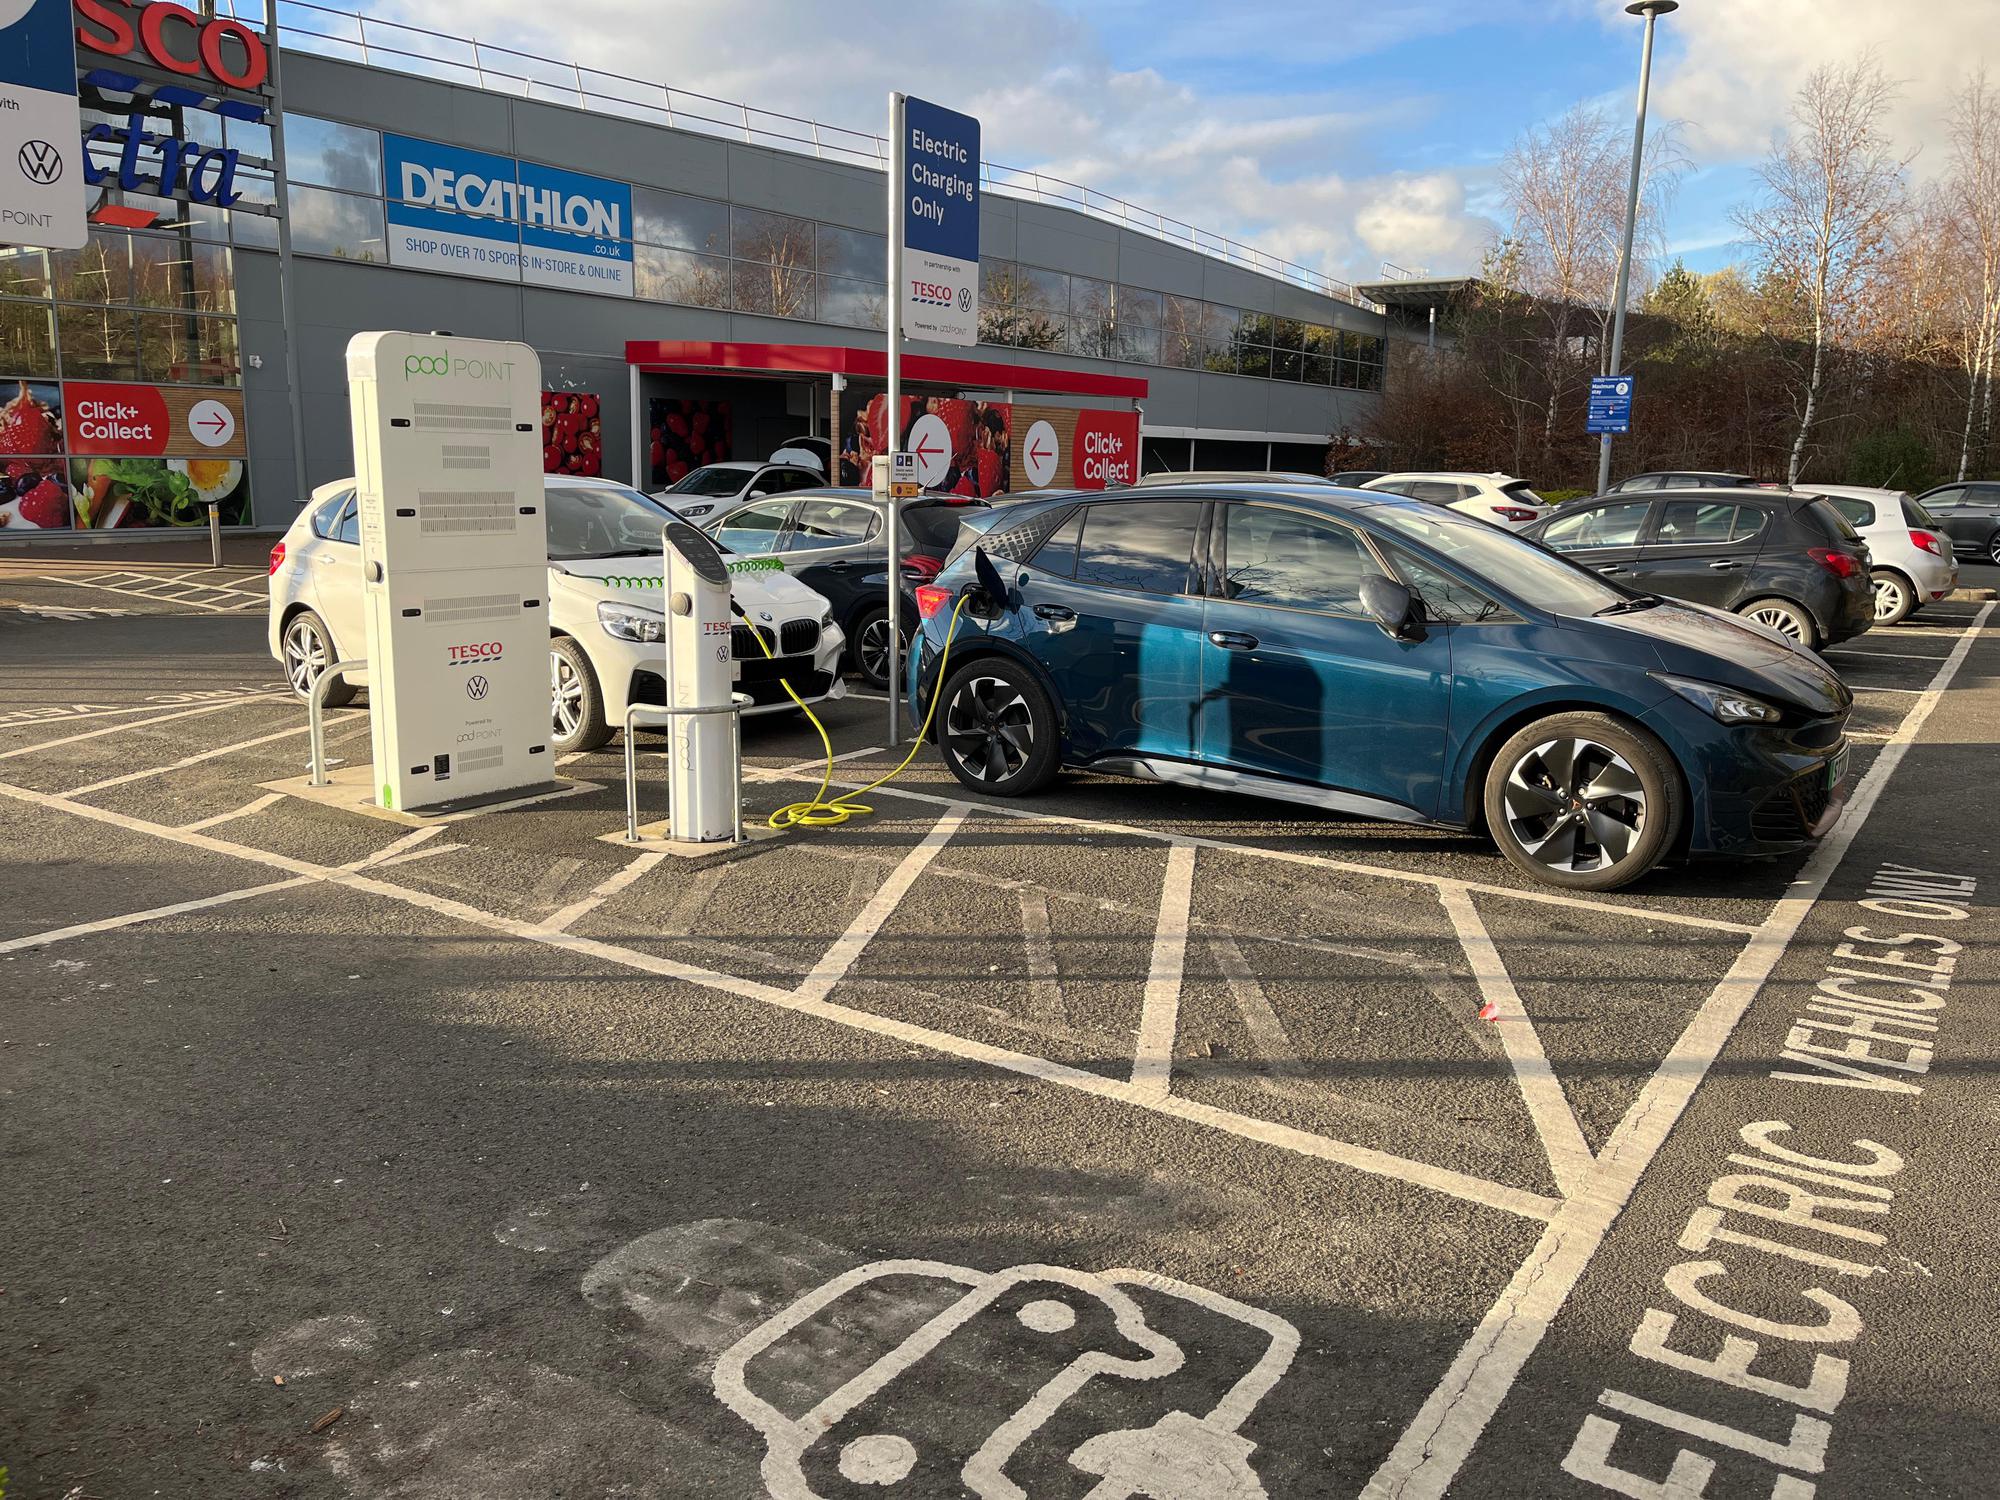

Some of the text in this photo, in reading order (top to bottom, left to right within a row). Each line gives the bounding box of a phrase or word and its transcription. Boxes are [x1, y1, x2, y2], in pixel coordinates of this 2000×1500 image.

[74, 0, 268, 89] SCO
[912, 128, 967, 163] Electric
[912, 163, 973, 202] Charging
[401, 161, 621, 243] DECATHLON
[912, 196, 944, 226] Only
[2, 209, 53, 228] POINT
[406, 238, 622, 281] SHOP OVER 70 SPORTS IN-STORE & ONLINE
[592, 244, 621, 257] .co.uk
[911, 281, 952, 301] TESCO
[405, 349, 516, 382] pod POINT
[77, 401, 139, 420] Click+
[79, 421, 153, 440] Collect
[1084, 431, 1123, 454] Click+
[1083, 457, 1129, 479] Collect
[703, 621, 732, 633] TESC
[448, 642, 503, 659] TESCO
[1560, 862, 1978, 1500] ELECTRIC VEHICLES ONLY
